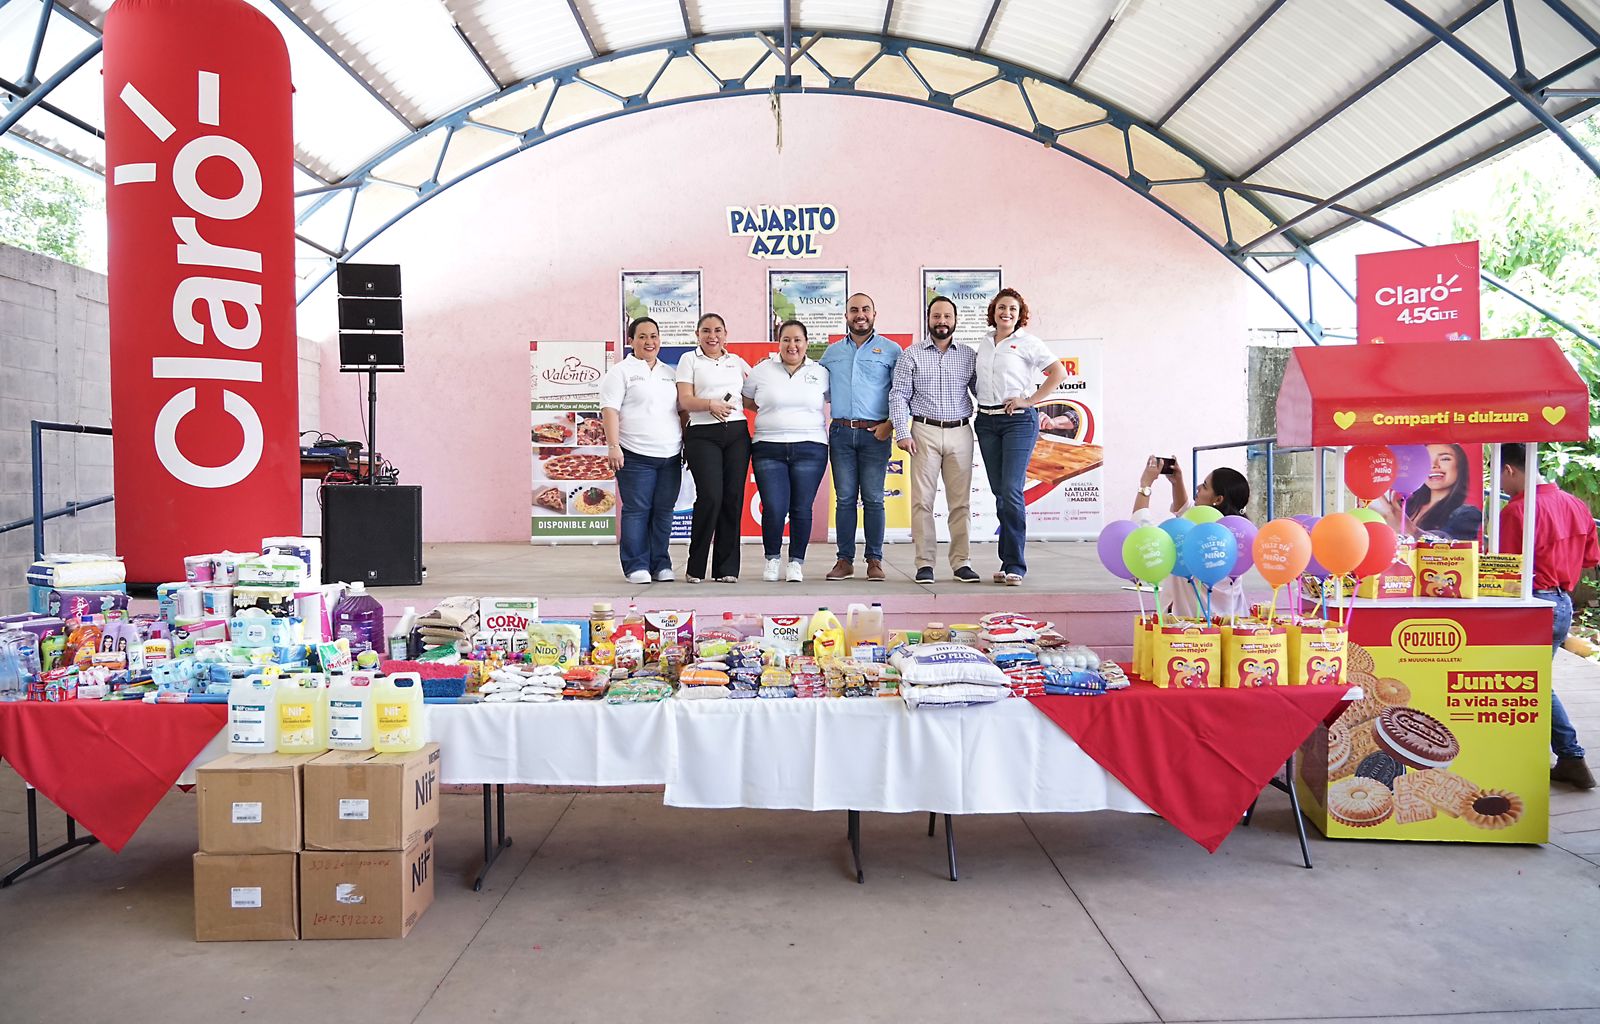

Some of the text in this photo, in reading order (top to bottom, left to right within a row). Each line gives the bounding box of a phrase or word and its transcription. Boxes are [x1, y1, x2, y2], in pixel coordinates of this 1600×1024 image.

[731, 206, 836, 233] PAJARITO
[752, 233, 817, 255] AZUL
[1375, 283, 1450, 307] Claro
[154, 133, 263, 488] Claro
[1372, 410, 1529, 426] Compartí la dulzura
[1374, 466, 1392, 474] NIÑO
[538, 519, 609, 529] DISPONIBLE AQUÍ
[1205, 551, 1226, 559] NIÑO
[486, 616, 529, 630] CORN
[1403, 631, 1456, 647] POZUELO
[535, 646, 557, 655] NIDO
[1450, 674, 1535, 691] Juntos
[1447, 696, 1538, 707] la vida sabe
[1478, 710, 1538, 726] mejor
